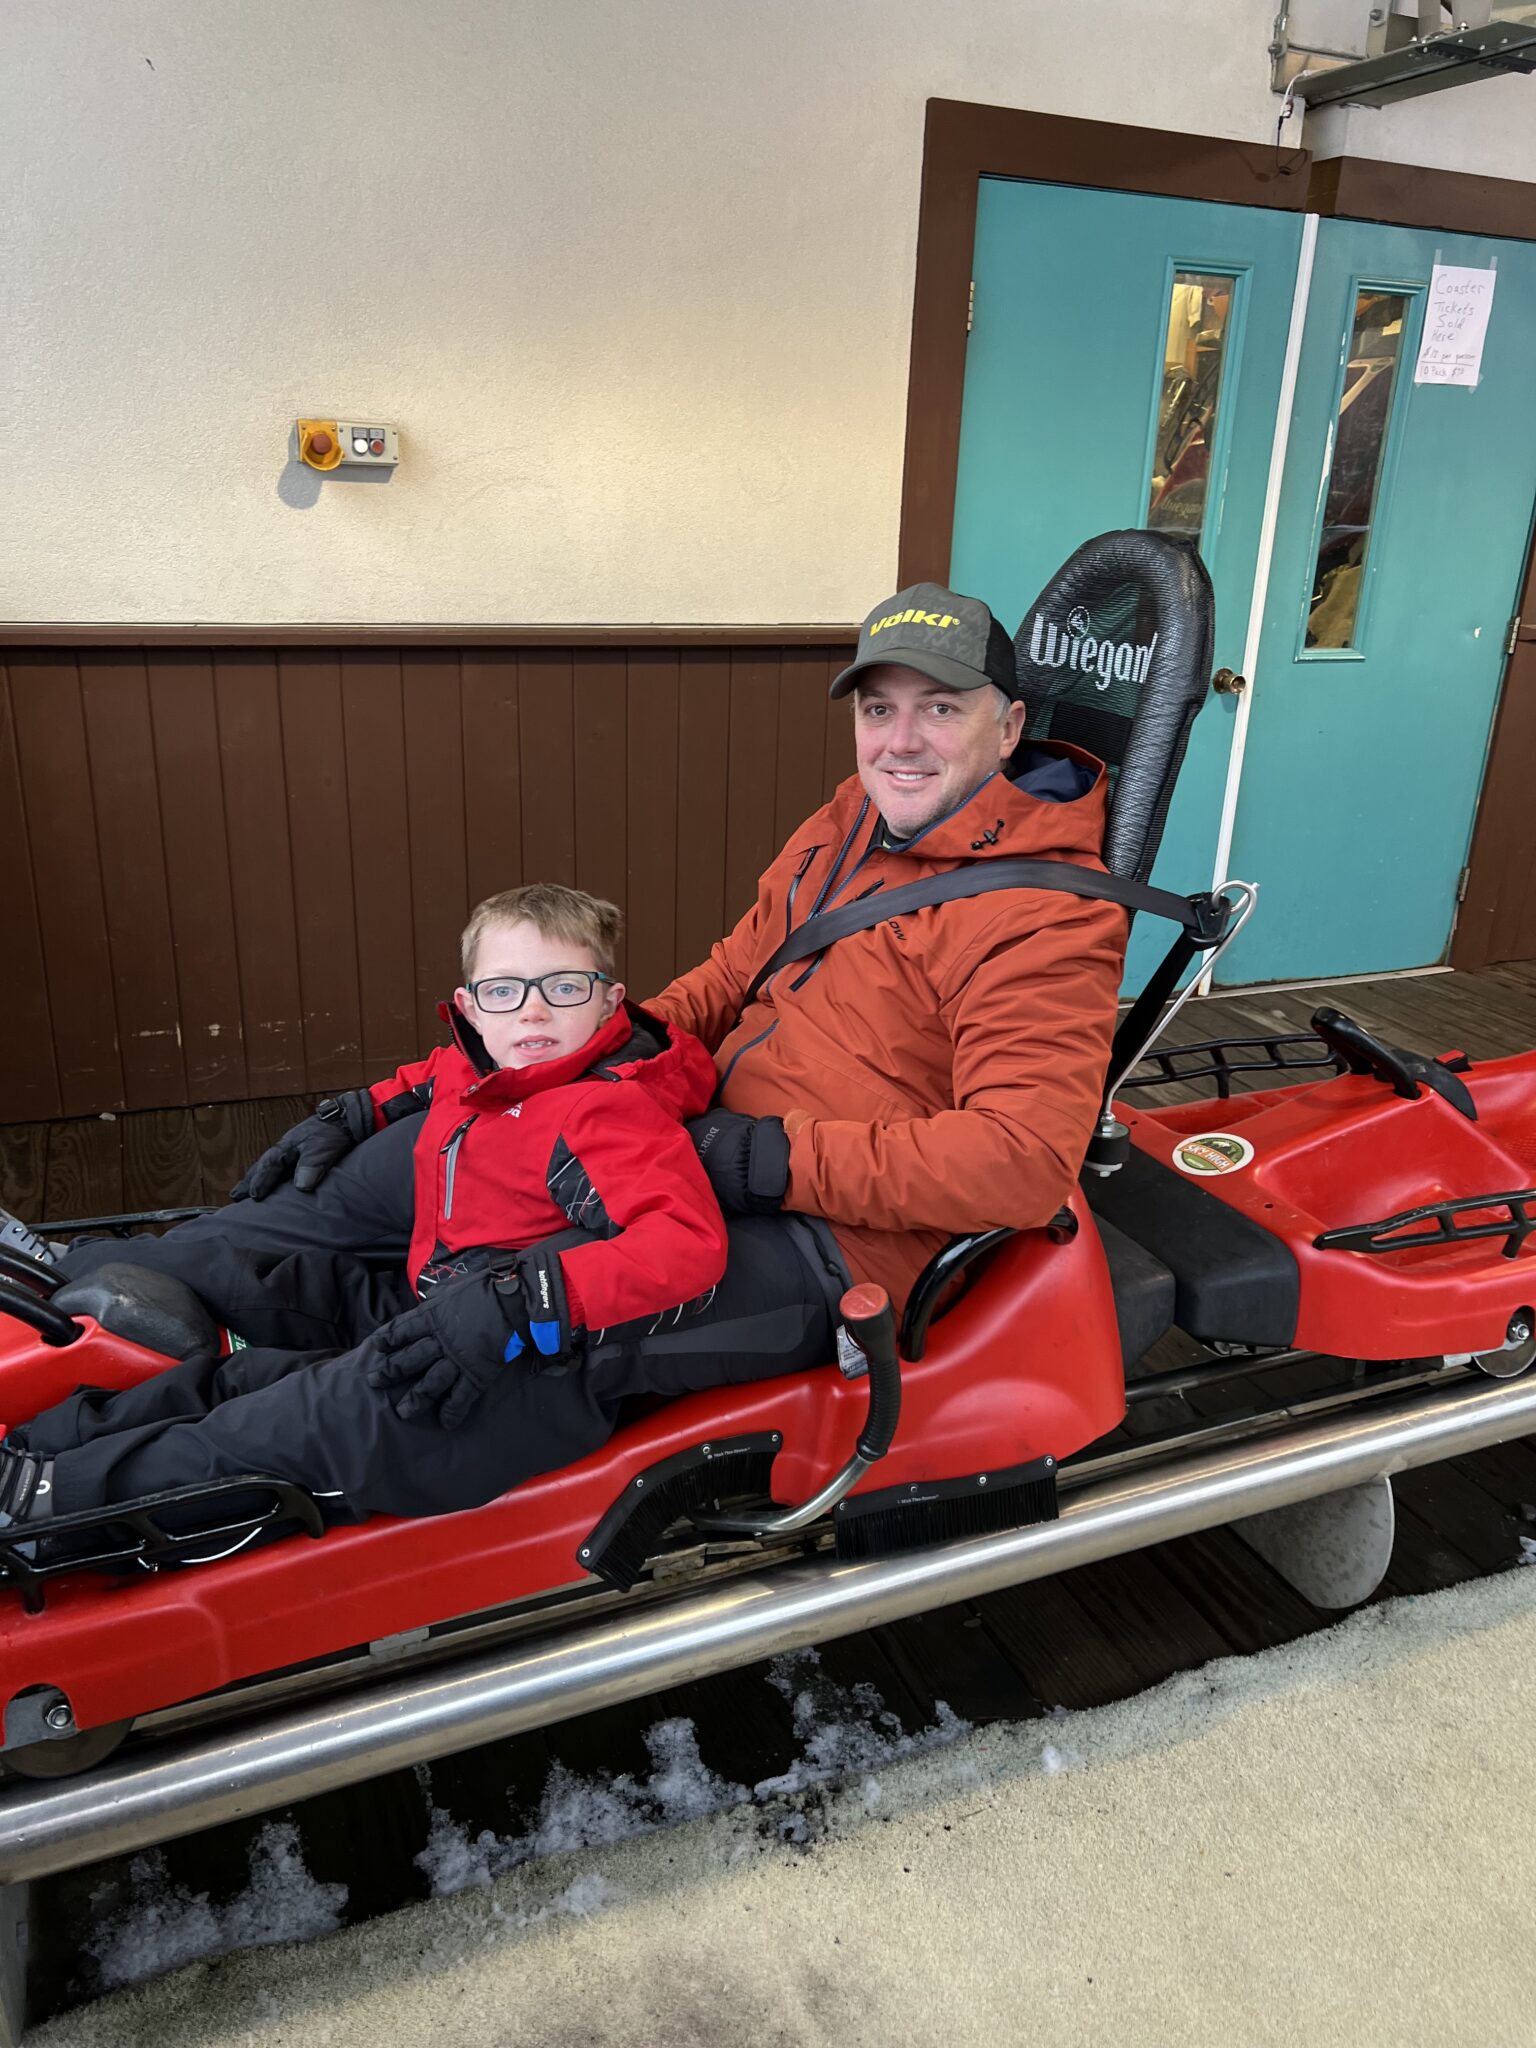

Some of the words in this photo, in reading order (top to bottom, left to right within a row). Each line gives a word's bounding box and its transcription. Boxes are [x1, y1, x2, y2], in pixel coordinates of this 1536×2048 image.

[1436, 273, 1486, 295] Coaster
[1434, 301, 1475, 316] Tickets
[1435, 313, 1466, 330] Sold
[698, 1126, 720, 1157] BURT
[1184, 1143, 1210, 1155] SKY
[1205, 1152, 1231, 1169] HIGH
